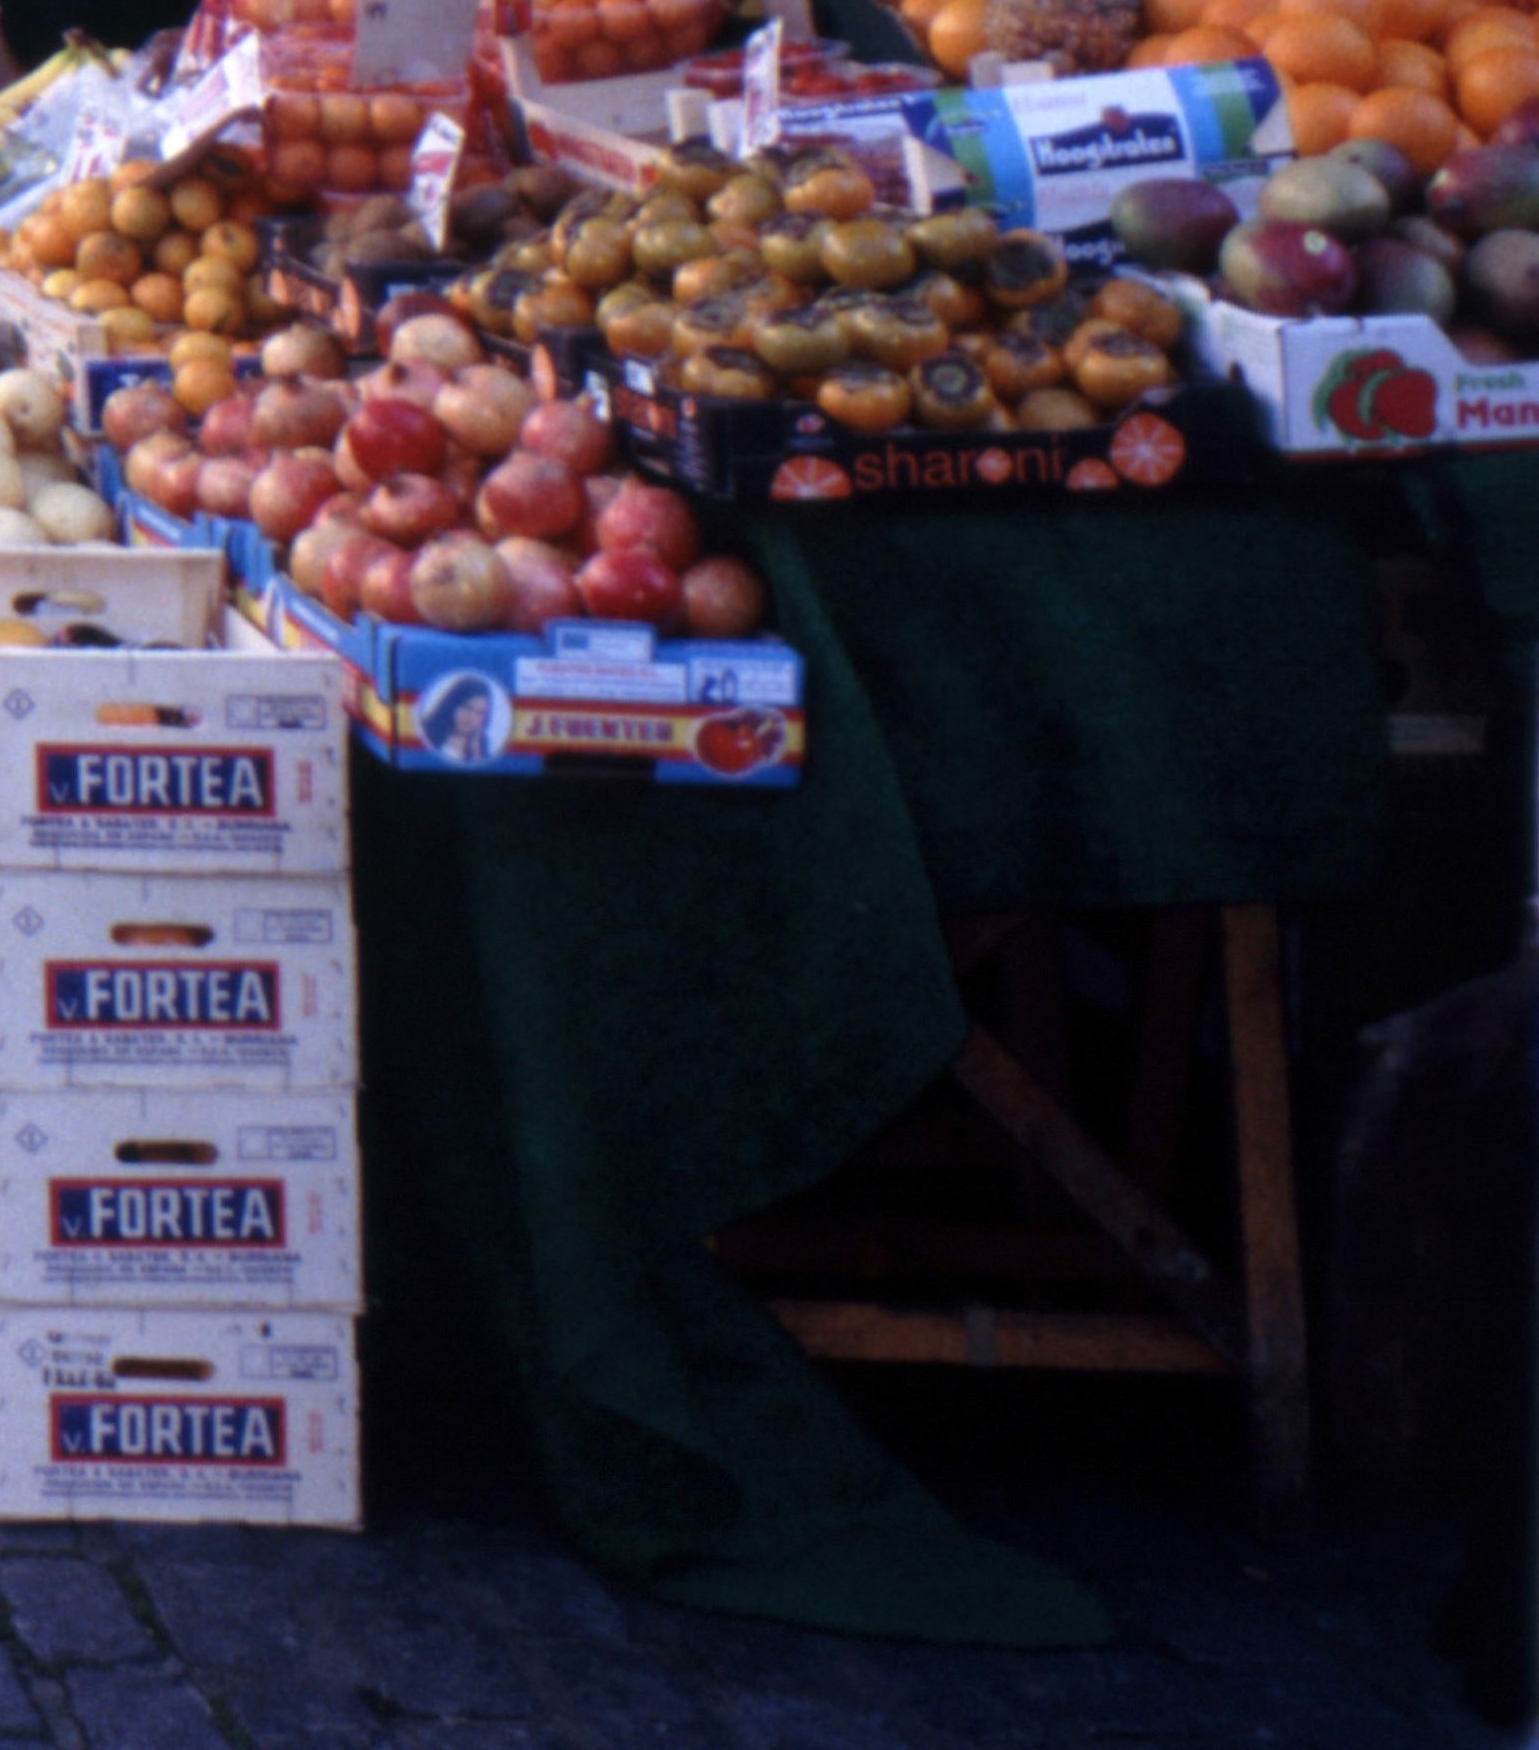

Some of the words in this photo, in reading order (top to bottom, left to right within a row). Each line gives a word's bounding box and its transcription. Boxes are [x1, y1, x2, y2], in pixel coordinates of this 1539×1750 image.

[853, 437, 1062, 490] sharoni
[75, 753, 264, 808] FORTEA
[85, 967, 272, 1022] FORTEA
[88, 1186, 276, 1241] FORTEA
[89, 1403, 276, 1458] FORTEA
